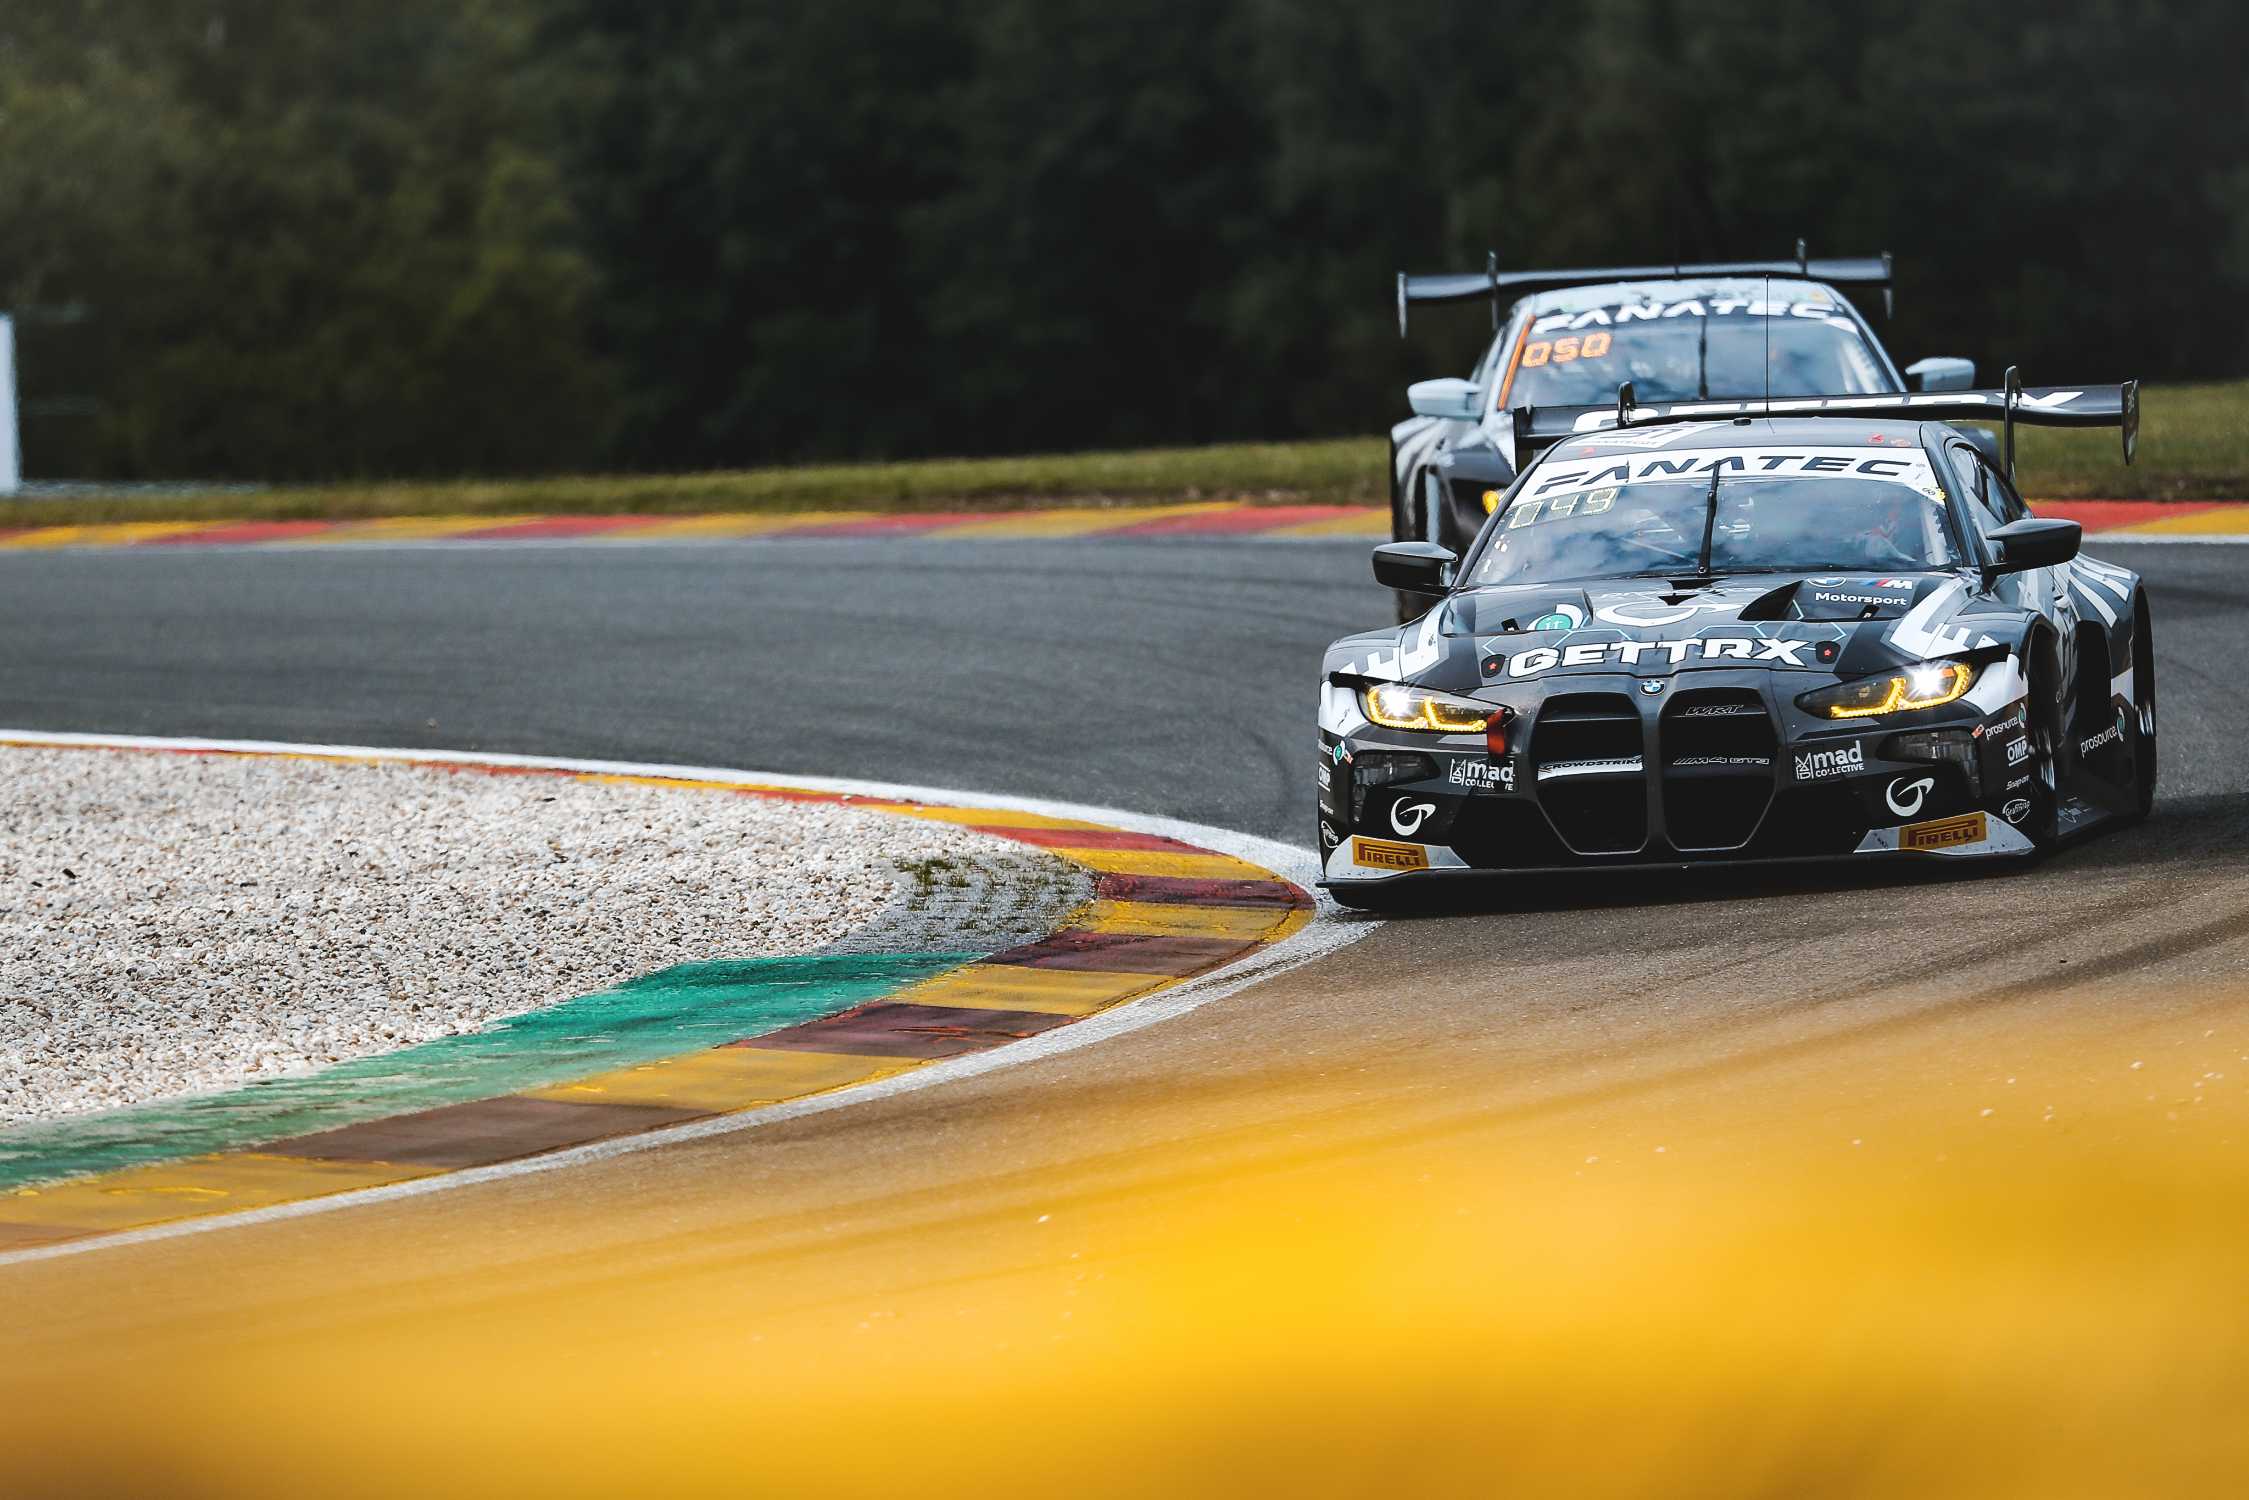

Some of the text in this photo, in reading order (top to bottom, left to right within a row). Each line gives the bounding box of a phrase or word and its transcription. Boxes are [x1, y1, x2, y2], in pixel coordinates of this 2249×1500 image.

[1531, 299, 1838, 335] FANATEC
[1533, 455, 1912, 495] FANATEC
[1815, 592, 1907, 606] Motorsport
[1508, 637, 1811, 678] GETTRX
[1813, 740, 1863, 769] mad
[2007, 740, 2028, 762] OMP
[2080, 726, 2118, 759] prosource
[1466, 761, 1515, 783] mad
[1815, 763, 1865, 777] COLLECTIVE
[1908, 819, 1979, 847] PIRELLI
[1358, 842, 1420, 866] PIRELLI
